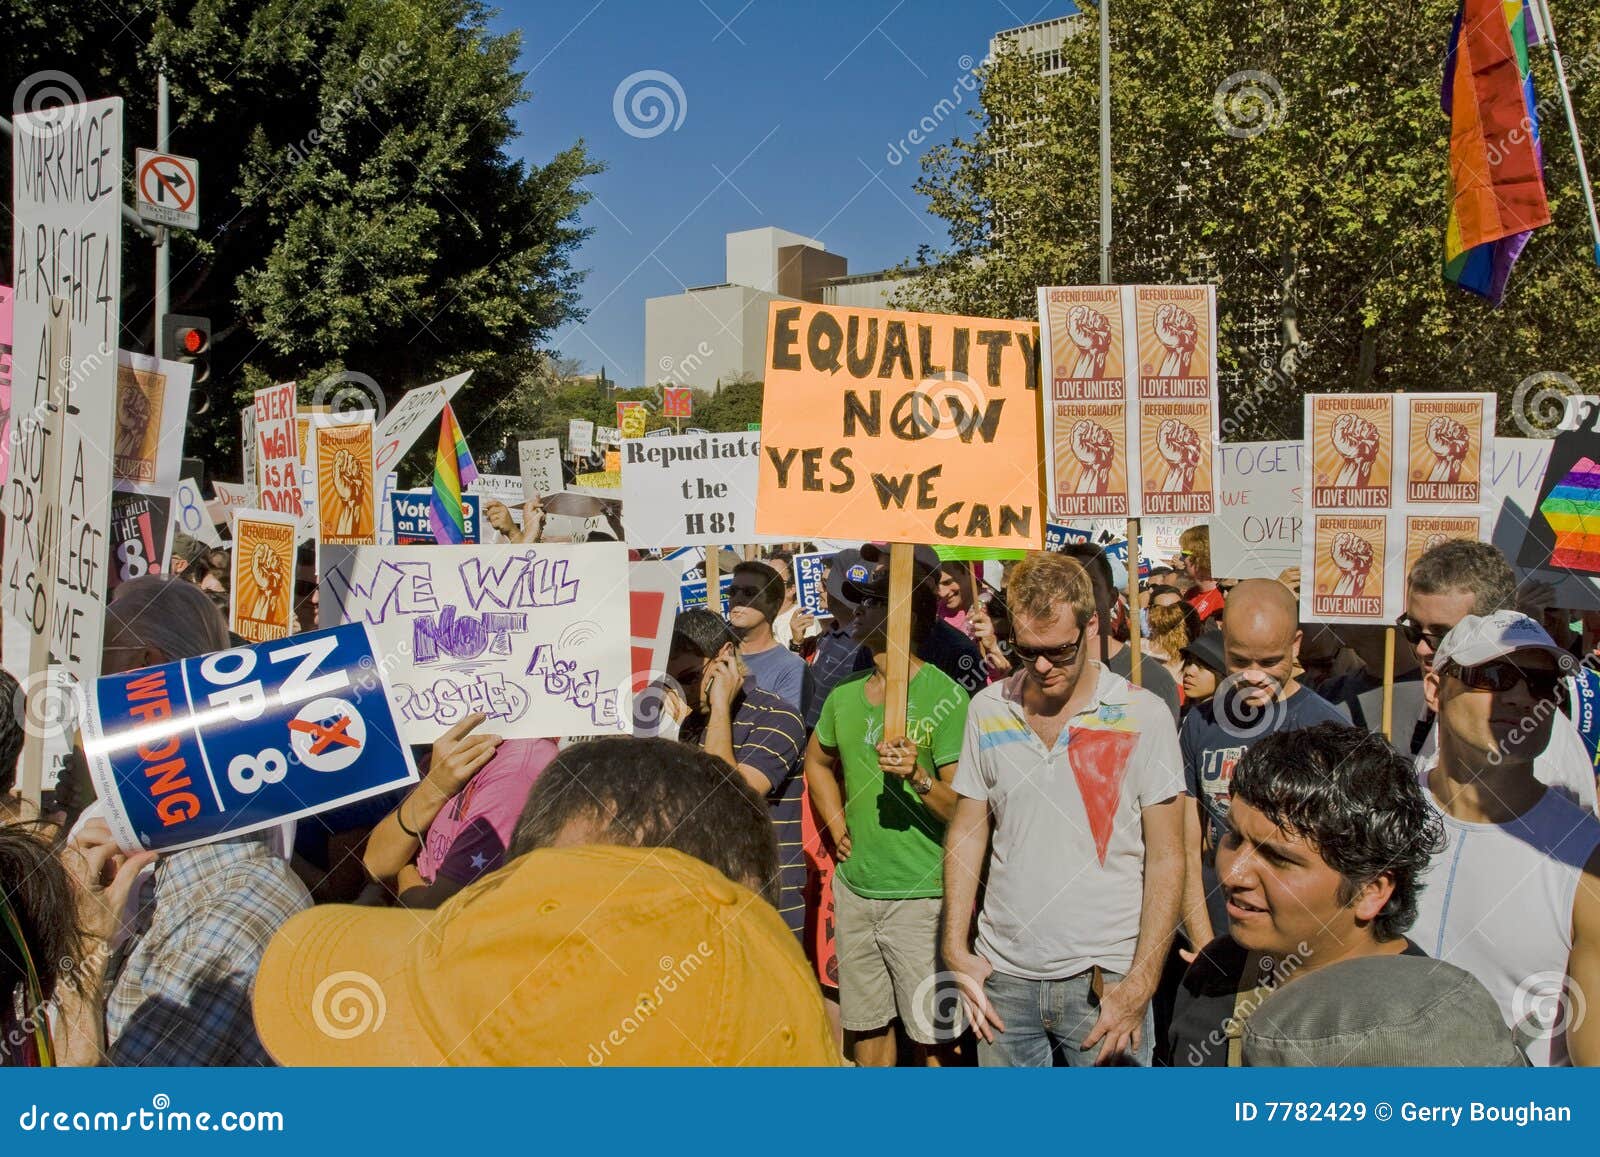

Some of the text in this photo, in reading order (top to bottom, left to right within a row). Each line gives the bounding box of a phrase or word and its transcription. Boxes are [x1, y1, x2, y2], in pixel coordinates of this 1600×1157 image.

[18, 108, 114, 204] MARRIAGE
[16, 223, 113, 355] A RIGHT 4
[1051, 290, 1117, 302] DEFEND EQUALITY
[1140, 289, 1204, 300] DEFEND EQUALITY
[773, 306, 1041, 391] EQUALITY
[1056, 380, 1122, 399] LOVE UNITES
[1143, 378, 1206, 397] LOVE UNITES
[256, 385, 296, 423] EVERY
[1058, 405, 1122, 416] DEFEND EQUALITY
[1144, 404, 1208, 415] DEFEND EQUALITY
[1318, 398, 1389, 411] DEFEND EQUALITY
[1414, 402, 1479, 414] DEFEND EQUALITY
[260, 418, 298, 460] Wall
[627, 437, 760, 468] Repudiate
[14, 414, 85, 519] NOT A
[265, 464, 281, 488] is
[284, 463, 297, 487] A
[765, 446, 856, 493] YES
[479, 478, 500, 490] Defy
[681, 478, 728, 499] the
[871, 464, 943, 511] WE
[1411, 483, 1476, 500] LOVE UNITES
[1059, 495, 1126, 514] LOVE UNITES
[1146, 495, 1210, 513] LOVE UNITES
[1221, 490, 1250, 506] WE
[1316, 488, 1387, 507] LOVE UNITES
[126, 500, 150, 517] RALLY
[179, 486, 203, 532] 8
[395, 500, 431, 518] Vote
[112, 516, 140, 542] THE
[398, 522, 413, 532] on
[584, 518, 599, 529] ON
[685, 512, 735, 535] H8!
[935, 501, 1032, 538] CAN
[1243, 516, 1303, 544] OVER
[1320, 518, 1383, 529] DEFEND EQUALITY
[1412, 520, 1476, 531] DEFEND EQUALITY
[325, 559, 439, 625] WE
[801, 558, 817, 615] VOTE NO
[1317, 597, 1380, 613] LOVE UNITES
[239, 619, 286, 641] LOVE UNITES
[392, 672, 532, 726] PUSHED
[125, 670, 201, 828] WRONG
[227, 747, 288, 794] 8
